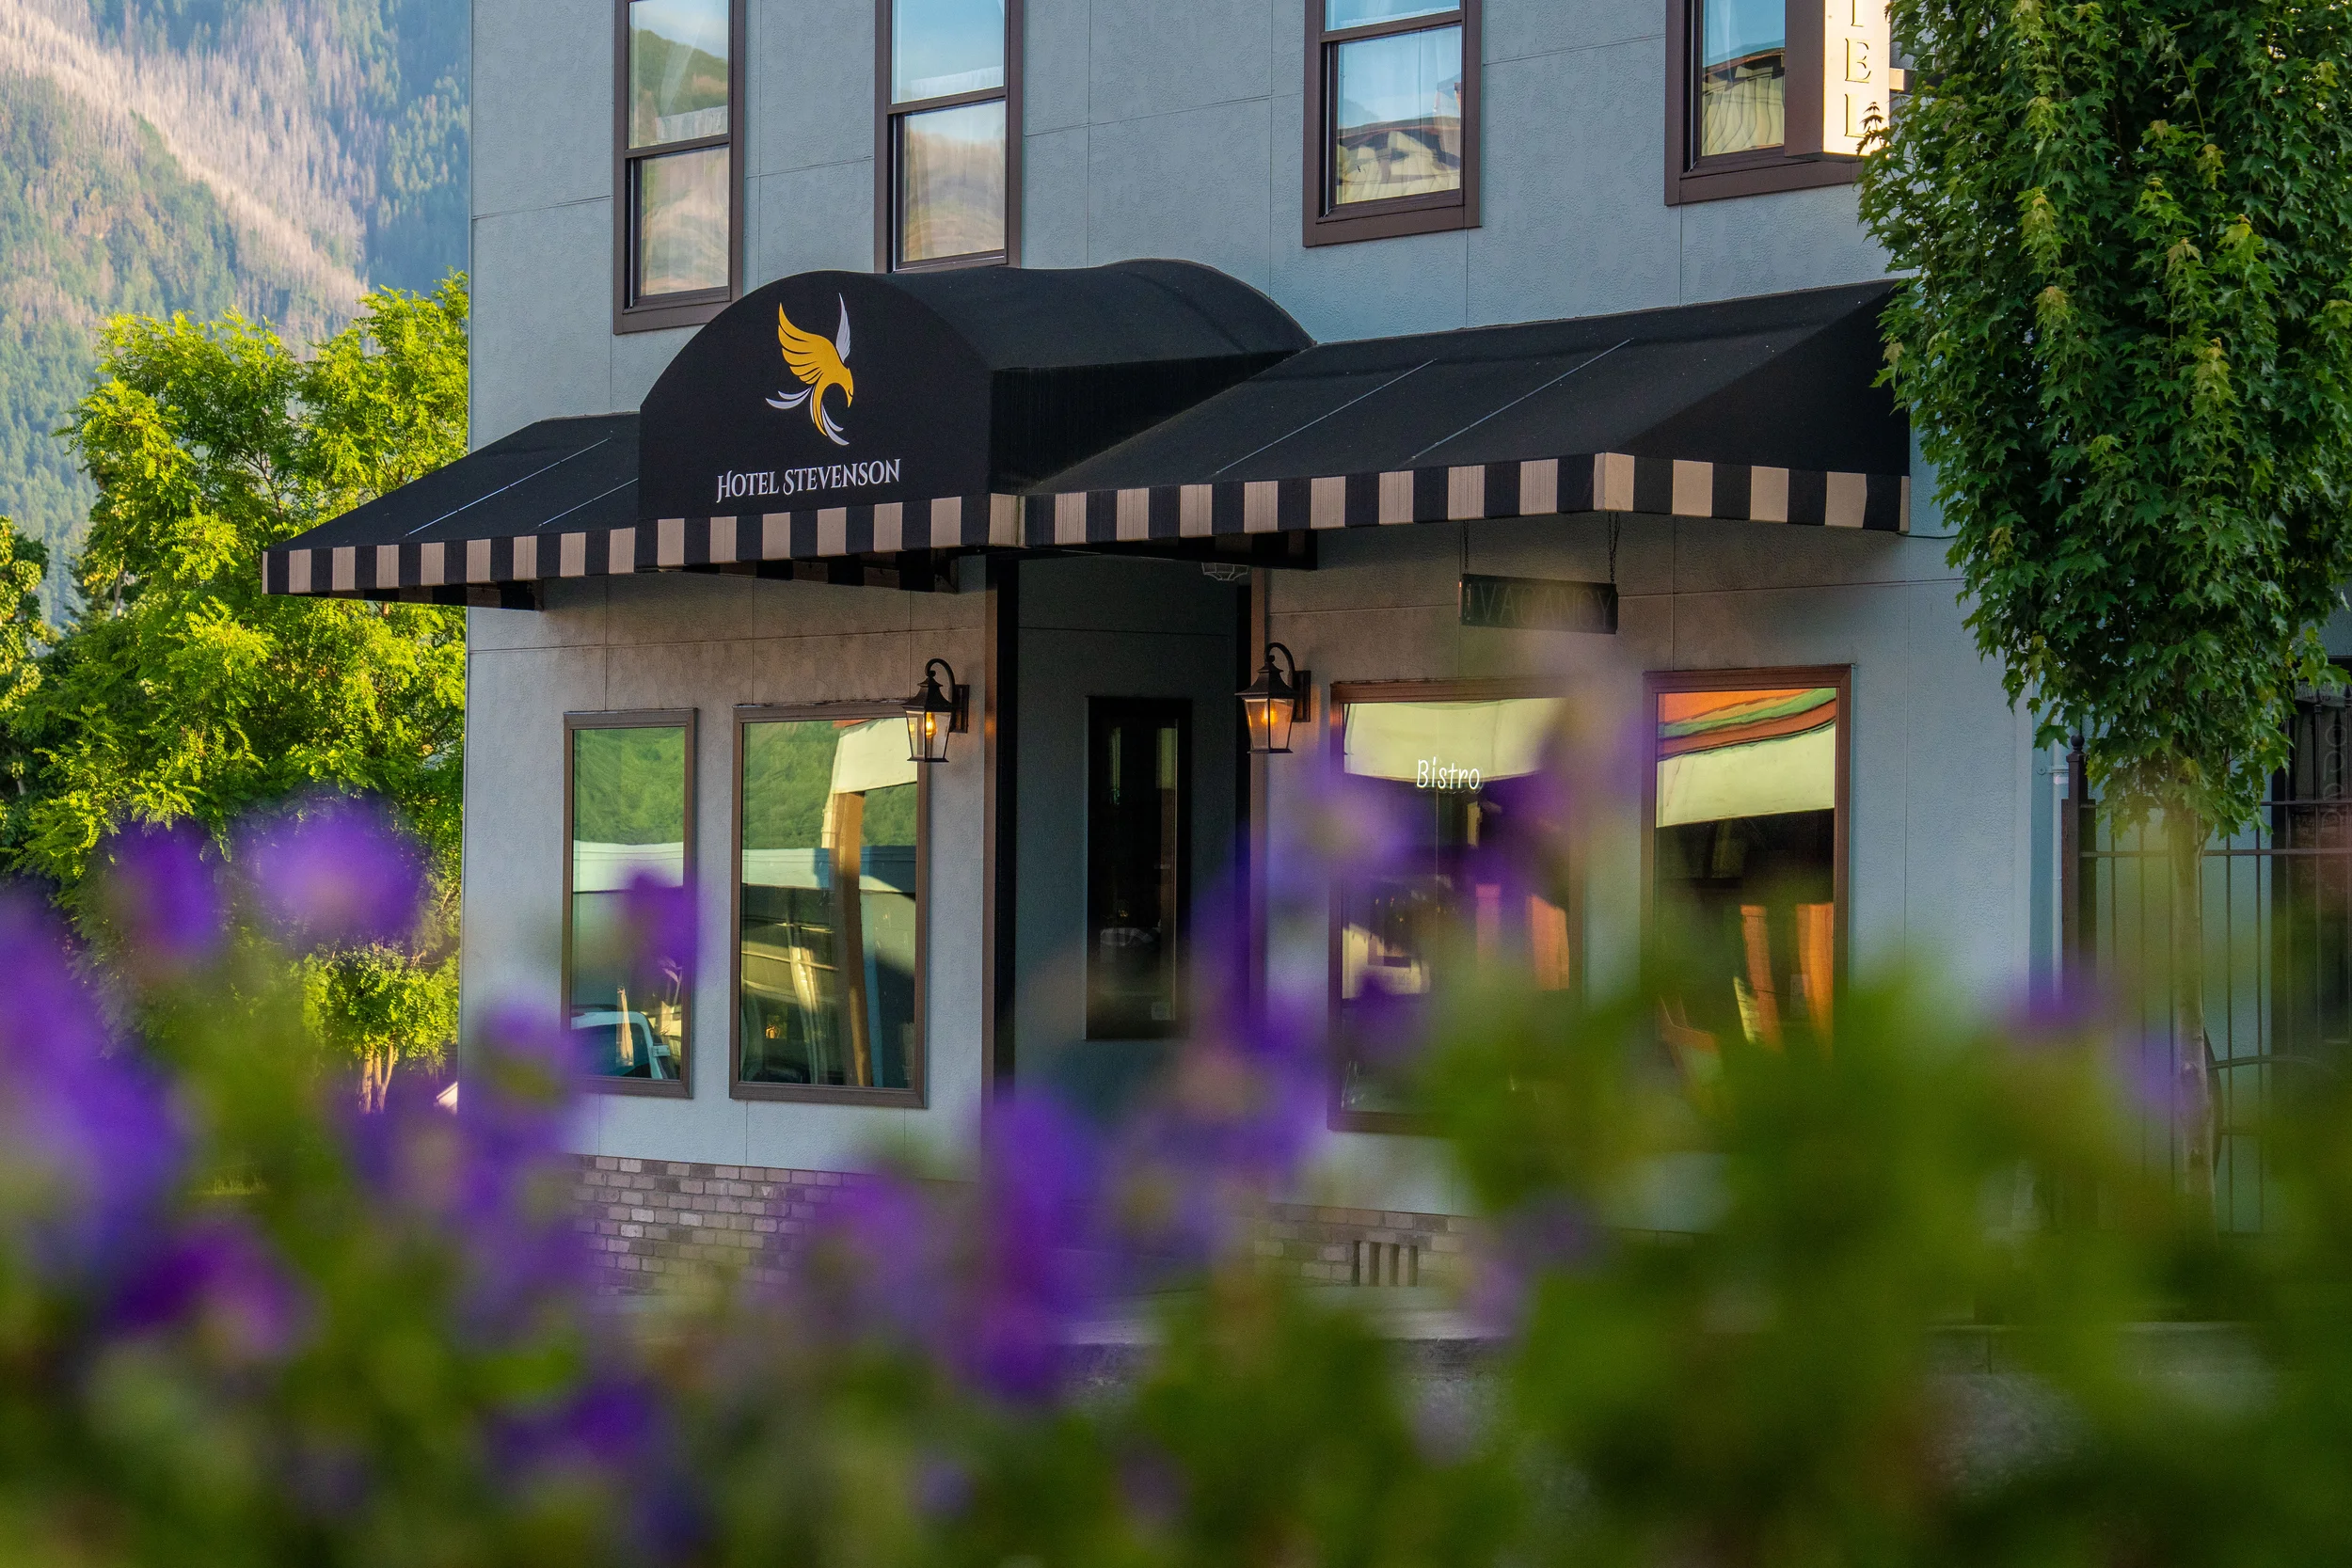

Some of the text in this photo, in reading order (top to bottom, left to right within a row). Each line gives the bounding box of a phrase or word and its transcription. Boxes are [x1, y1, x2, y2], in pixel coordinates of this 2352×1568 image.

[716, 458, 901, 503] HOTEL STEVENSON
[1478, 582, 1613, 630] VACANCY
[1416, 756, 1481, 790] Bistro
